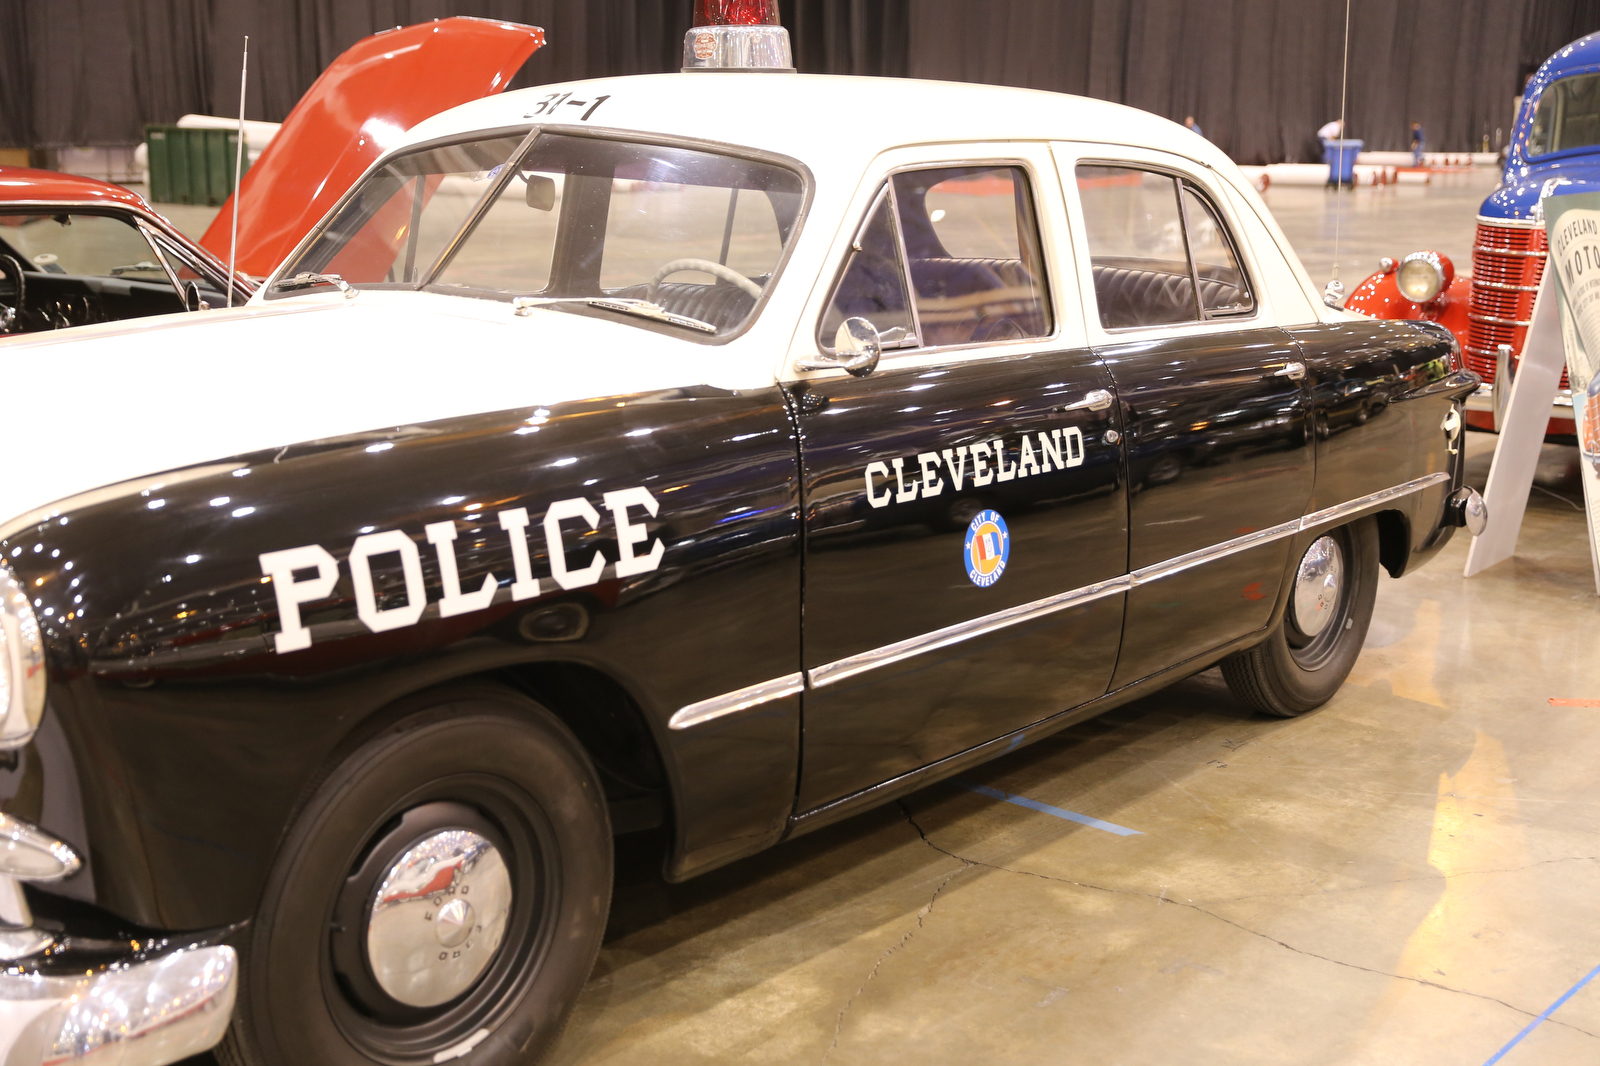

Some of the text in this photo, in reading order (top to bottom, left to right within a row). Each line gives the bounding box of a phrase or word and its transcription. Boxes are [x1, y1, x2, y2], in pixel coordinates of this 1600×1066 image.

[523, 91, 611, 121] 31-1
[1558, 218, 1598, 256] CLEVELAND
[864, 425, 1085, 509] CLEVELAND
[970, 511, 1000, 532] CITY OF
[258, 485, 666, 655] POLICE
[969, 560, 1006, 587] CLEVELAND
